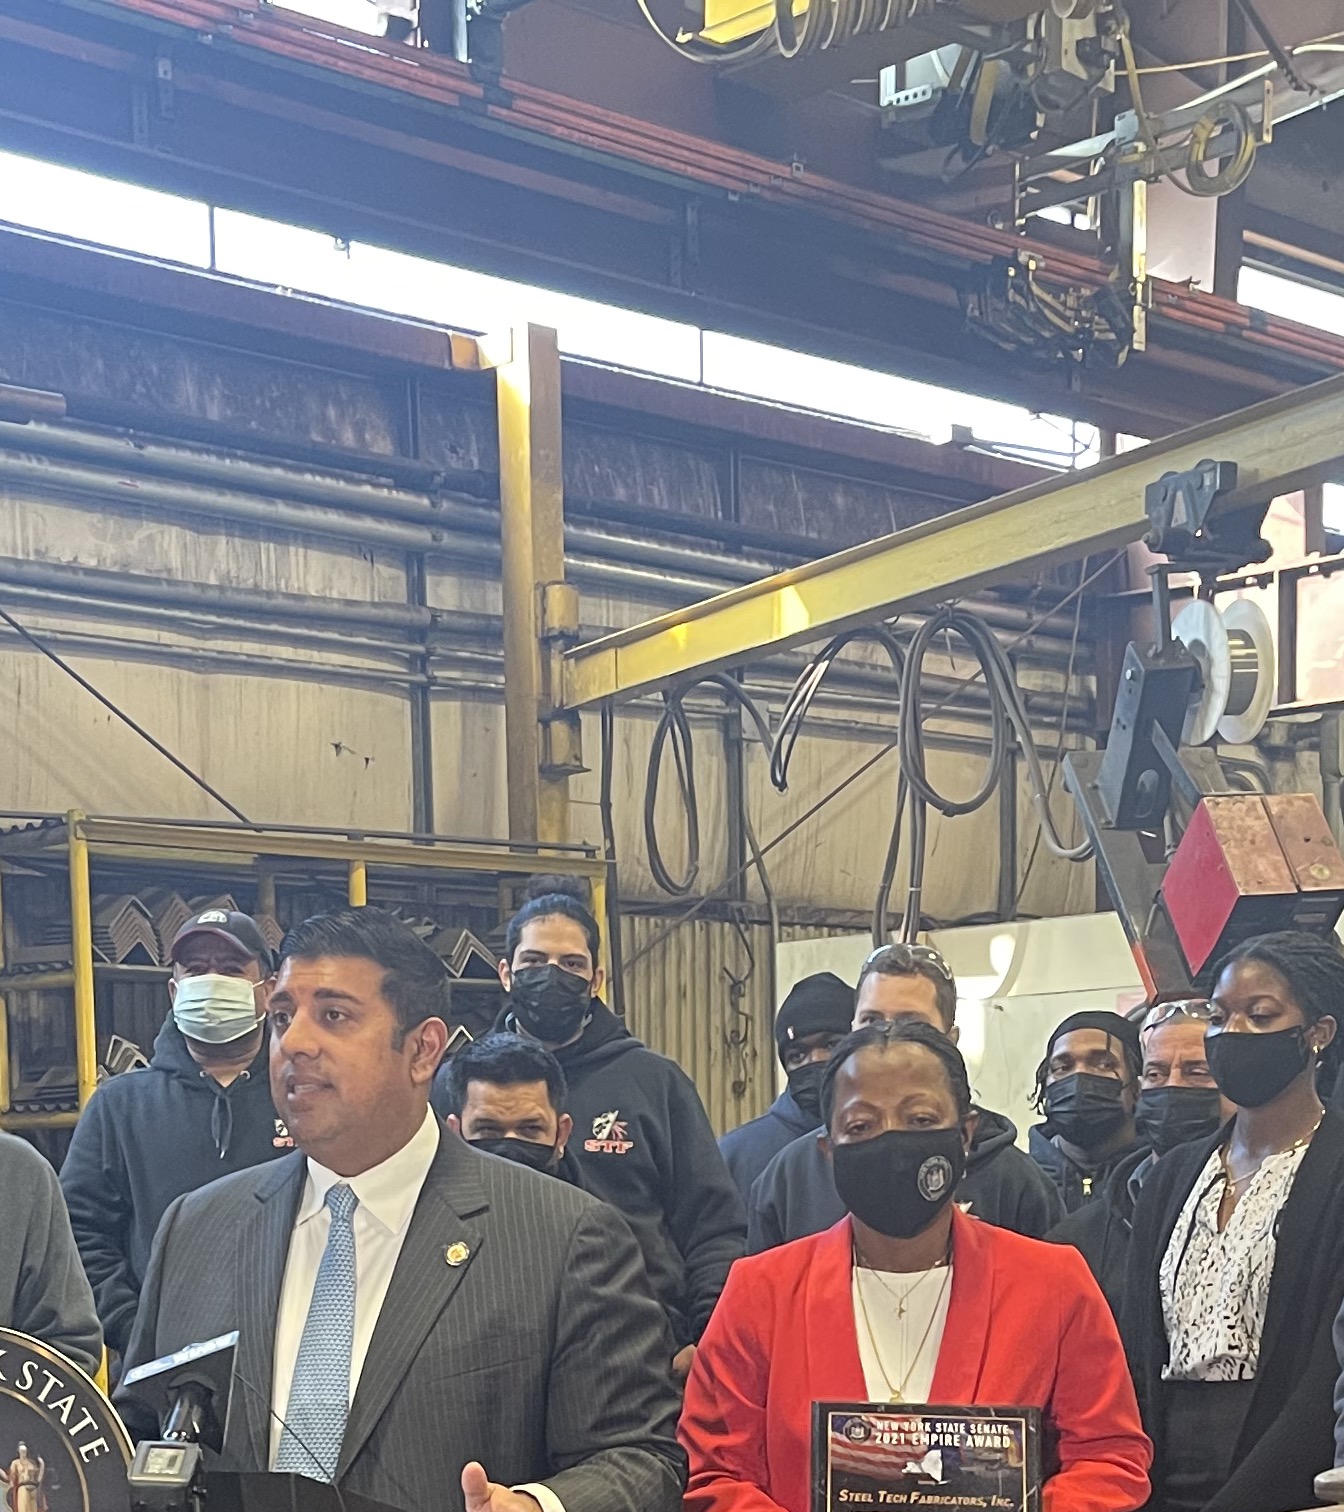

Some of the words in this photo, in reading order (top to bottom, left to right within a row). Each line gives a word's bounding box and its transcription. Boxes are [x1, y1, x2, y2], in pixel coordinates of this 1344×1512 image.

[14, 1359, 111, 1464] STATE
[876, 1420, 900, 1432] NEW
[903, 1421, 932, 1433] YORK
[935, 1422, 966, 1434] STATE
[969, 1423, 1010, 1435] SENATE
[875, 1432, 905, 1445] 2021
[911, 1434, 961, 1447] EMPIRE
[965, 1435, 1011, 1448] AWARD
